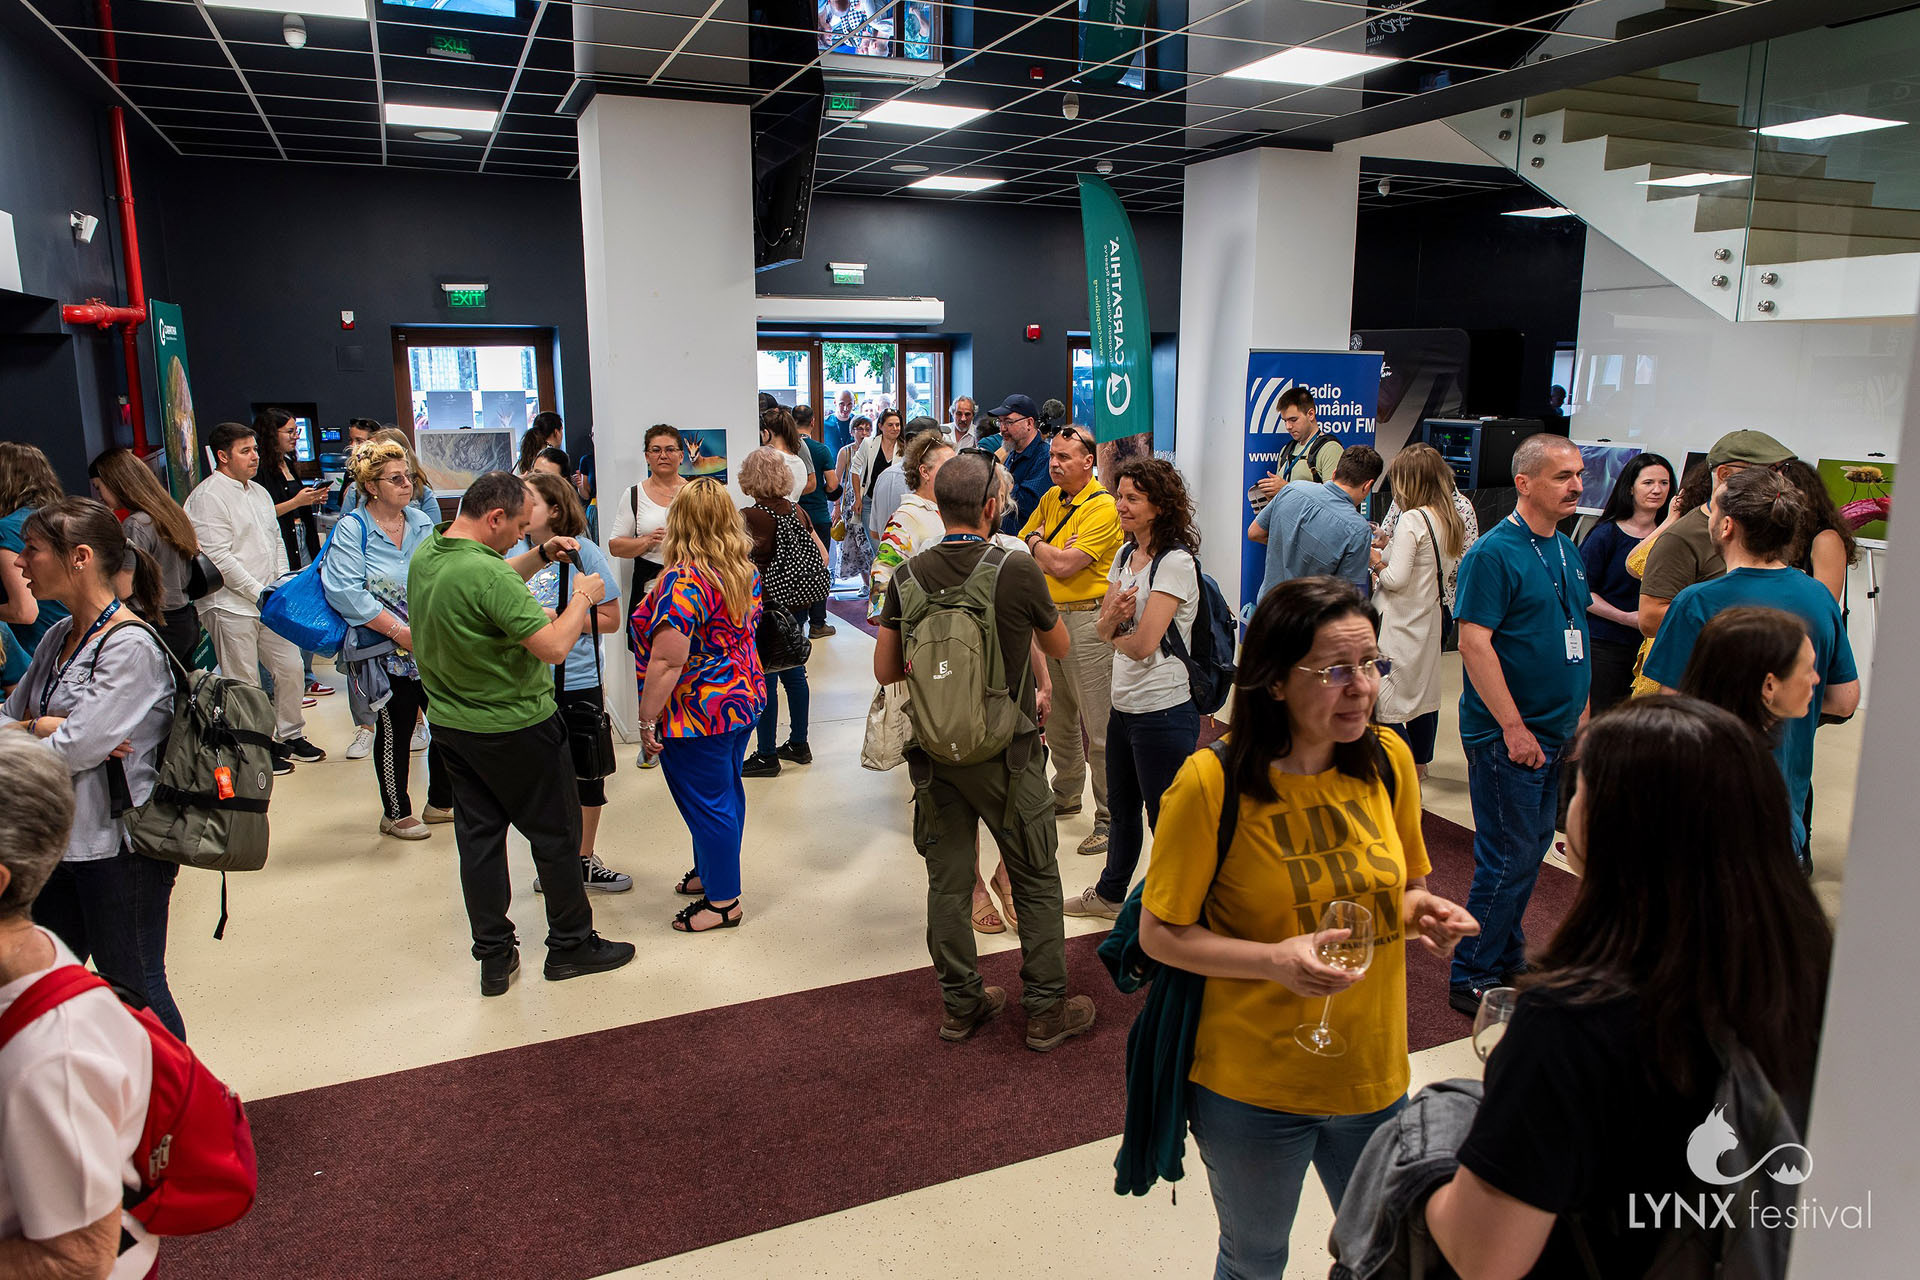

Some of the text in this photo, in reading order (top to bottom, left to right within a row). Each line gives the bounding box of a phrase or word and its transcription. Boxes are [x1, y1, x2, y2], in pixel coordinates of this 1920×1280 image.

[450, 293, 482, 306] EXIT
[1313, 400, 1363, 416] omânia
[1318, 417, 1376, 434] asov FM
[1248, 452, 1280, 463] www
[1268, 796, 1382, 858] LDN
[1280, 842, 1400, 906] PRS
